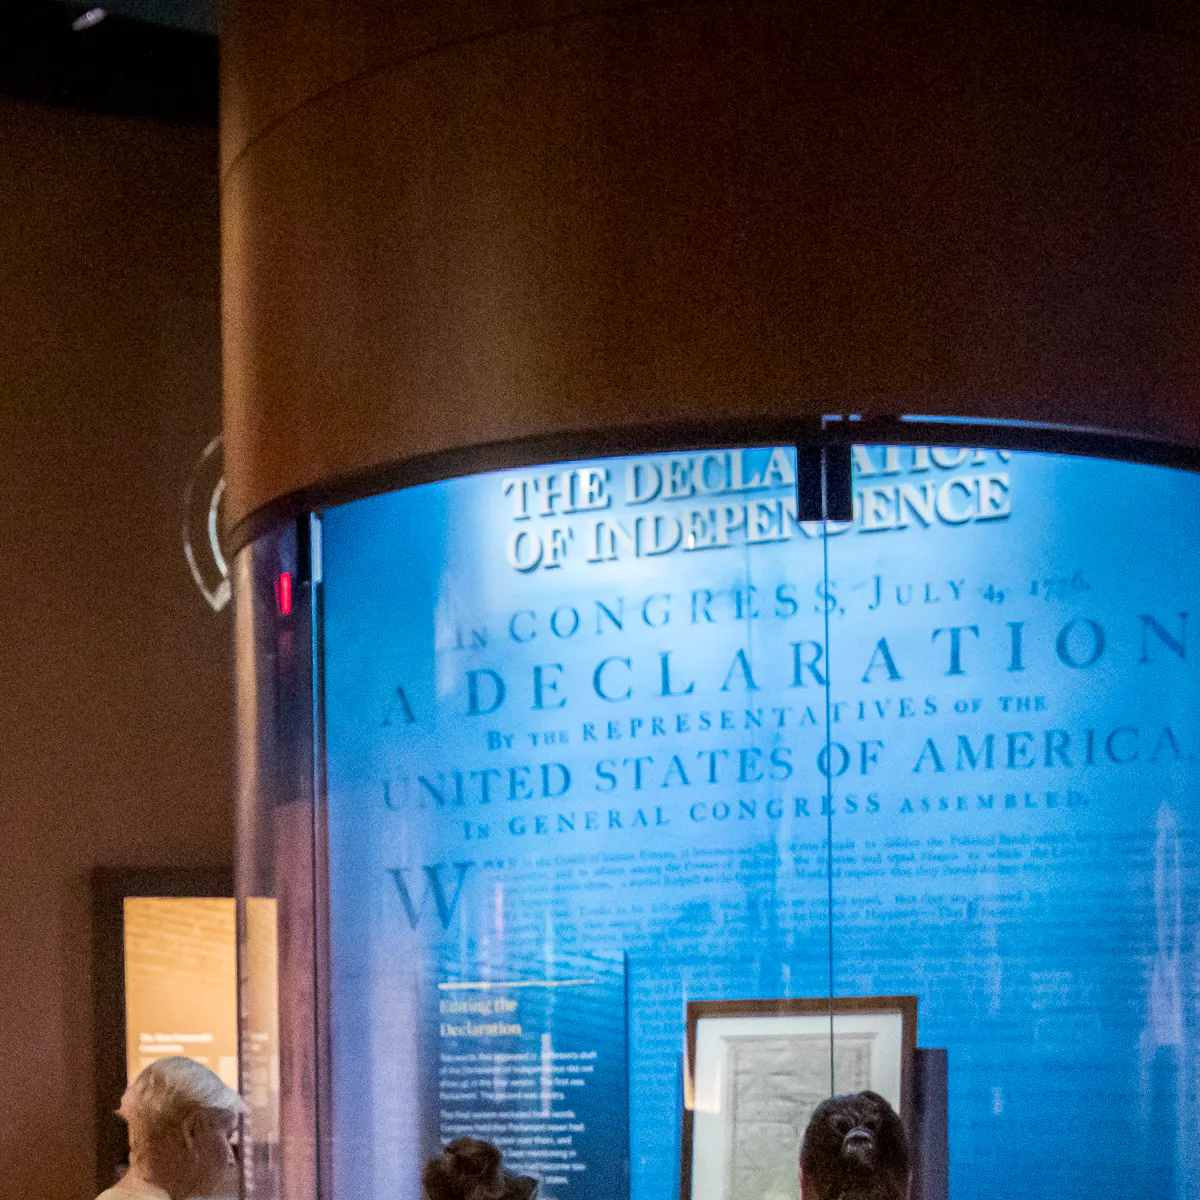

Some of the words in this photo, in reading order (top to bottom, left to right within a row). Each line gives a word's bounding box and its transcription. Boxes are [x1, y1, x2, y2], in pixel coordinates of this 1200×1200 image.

[502, 466, 612, 521] THE
[625, 444, 1013, 505] DECLAATI
[505, 519, 574, 573] OF
[508, 578, 845, 643] CONGRESS,
[868, 575, 965, 611] JULY
[382, 685, 415, 726] A
[464, 611, 1190, 717] DECLARATION
[582, 696, 938, 741] REPRESENTATIVES
[1000, 694, 1049, 713] THE
[383, 761, 572, 811] UNITED
[595, 747, 793, 792] STATES
[816, 739, 885, 779] OF
[508, 806, 670, 836] GENERAL
[689, 792, 882, 821] CONGRESS
